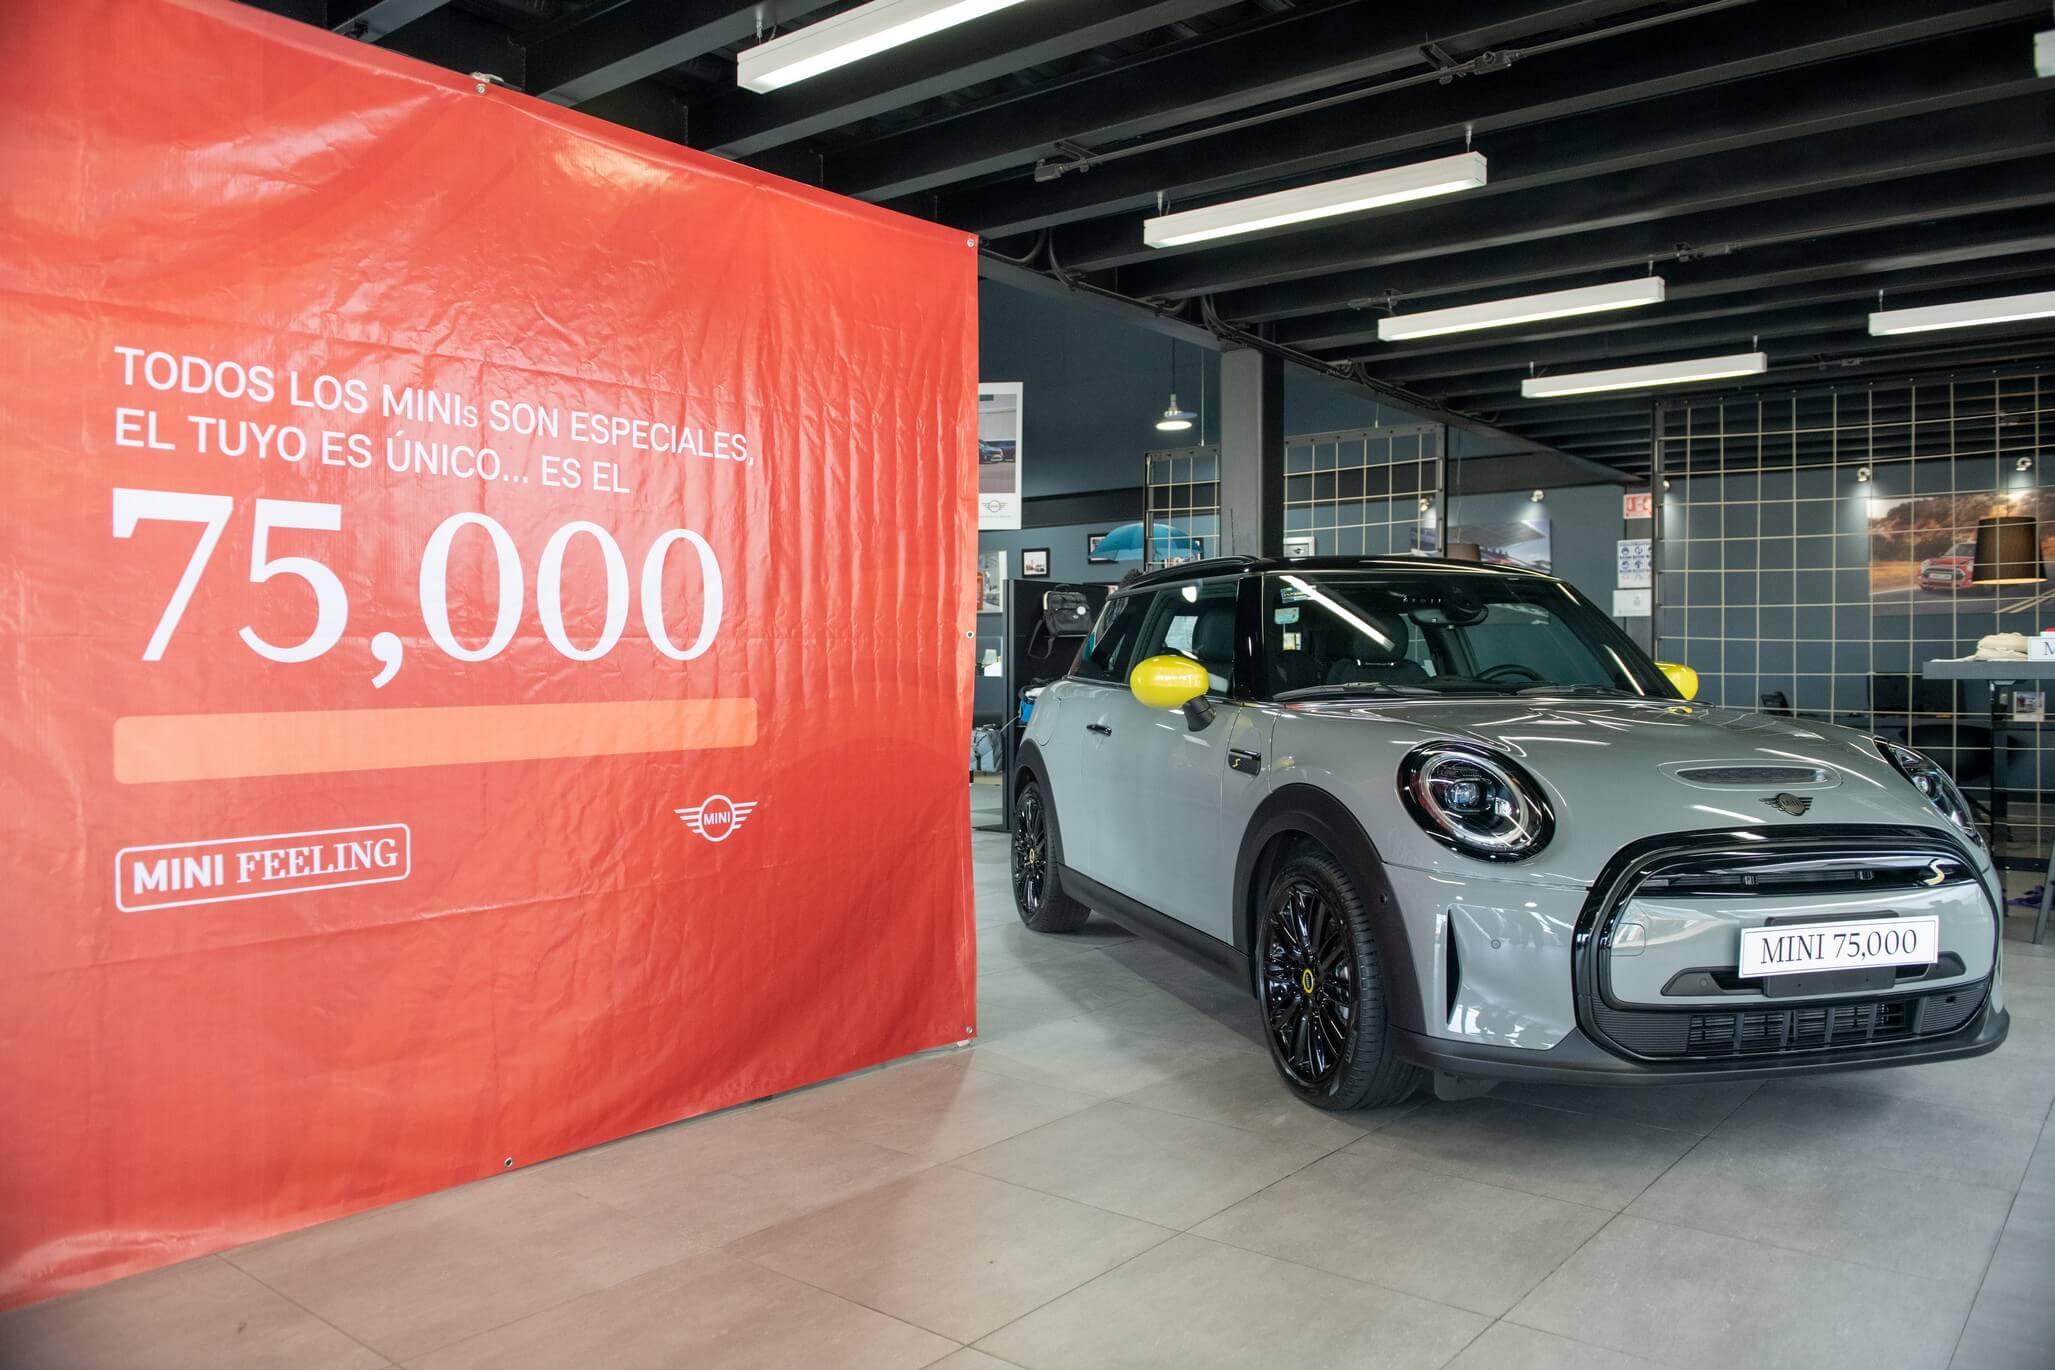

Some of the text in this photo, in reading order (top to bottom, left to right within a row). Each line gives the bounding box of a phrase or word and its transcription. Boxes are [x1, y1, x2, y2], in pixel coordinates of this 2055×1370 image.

[113, 345, 754, 467] TODOS LOS MINIs SON ESPECIALES,
[115, 407, 631, 494] EL TUYO ES ÚNICO... ES EL
[112, 487, 724, 689] 75,000
[703, 811, 731, 826] MINI
[133, 838, 399, 895] MINI FEELING
[1760, 929, 1918, 965] MINI 75,000
